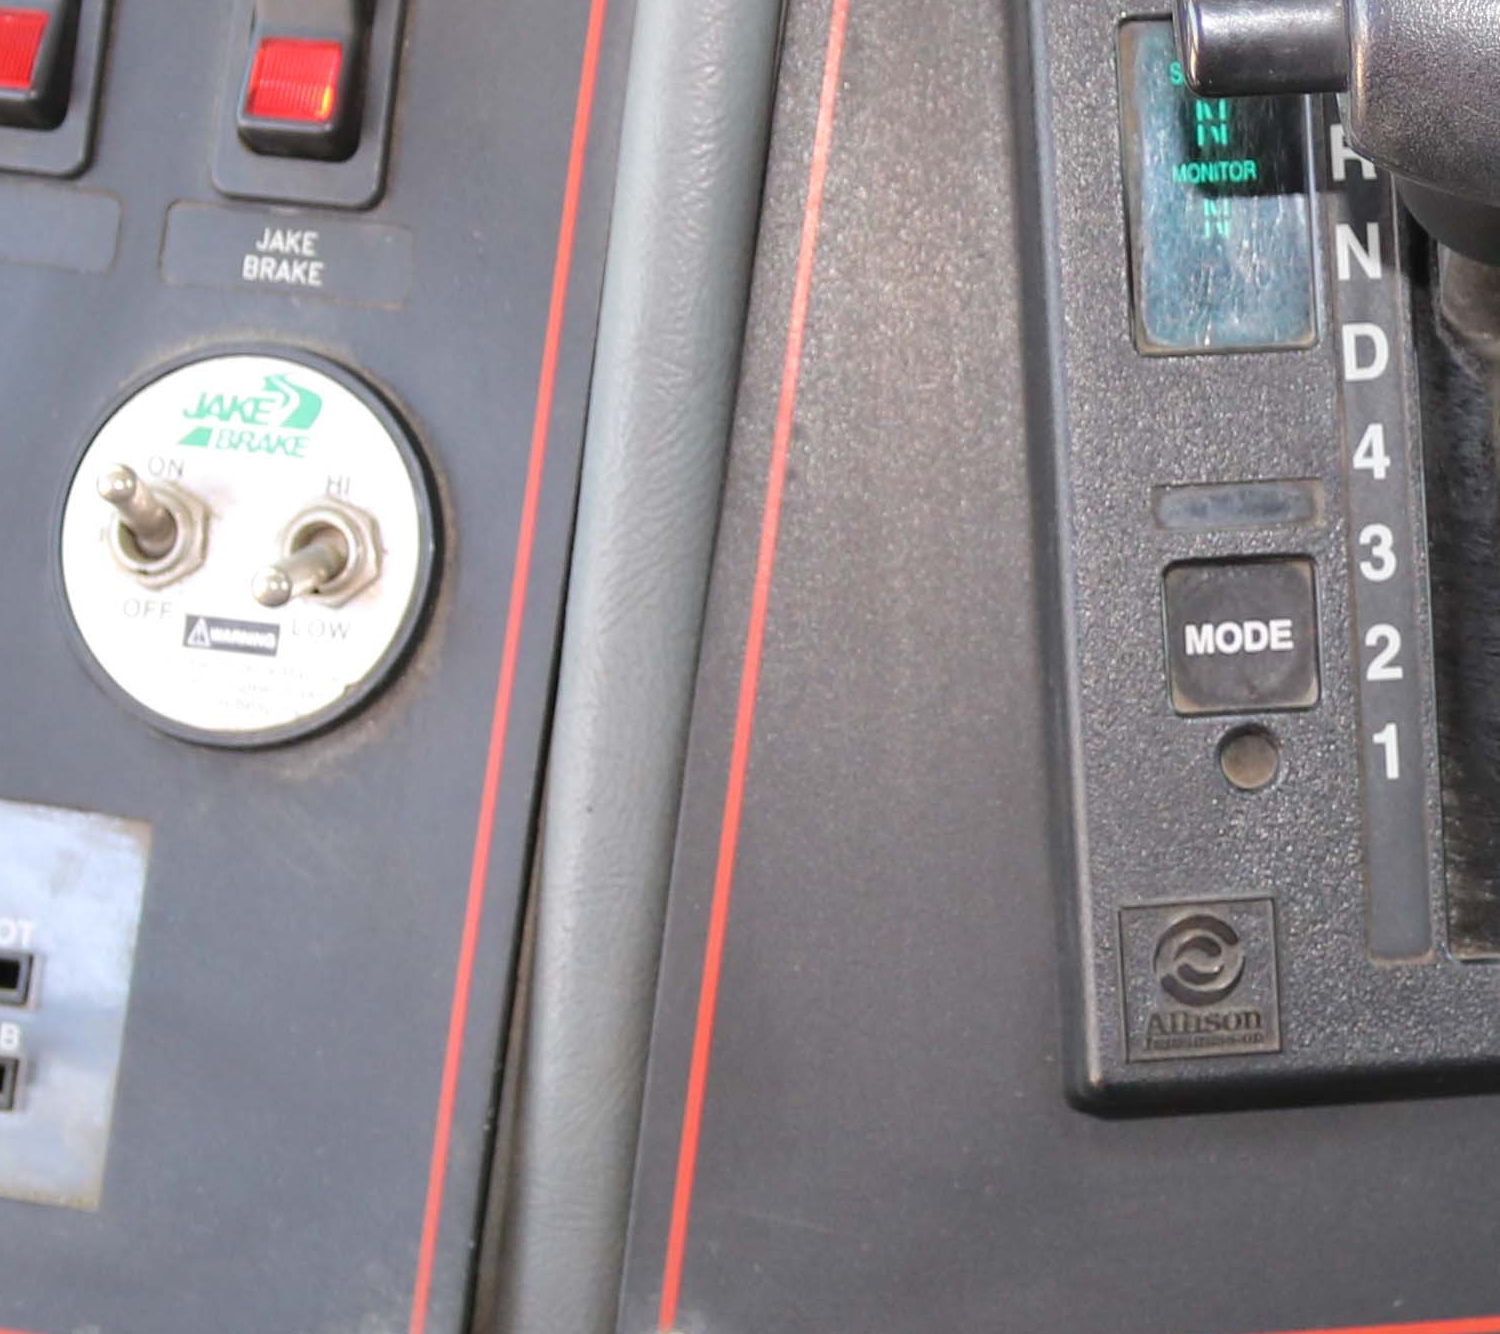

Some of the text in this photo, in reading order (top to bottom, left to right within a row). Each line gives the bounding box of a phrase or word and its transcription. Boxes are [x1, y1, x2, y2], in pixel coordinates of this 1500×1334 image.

[1172, 160, 1258, 185] MONITOR
[255, 226, 319, 257] JAKE
[1335, 222, 1383, 281] N
[241, 253, 324, 287] BRAKE
[1341, 322, 1390, 381] D
[183, 390, 277, 426] JAKE
[214, 427, 310, 459] BRAKE
[1352, 423, 1391, 480] 4
[147, 454, 185, 479] ON
[325, 474, 351, 495] HI
[1358, 523, 1397, 582] 3
[123, 598, 173, 620] OFF
[291, 618, 351, 641] LOW
[1184, 619, 1294, 656] MODE
[1364, 623, 1404, 681] 2
[1372, 723, 1400, 780] 1
[1147, 1010, 1262, 1035] Allison
